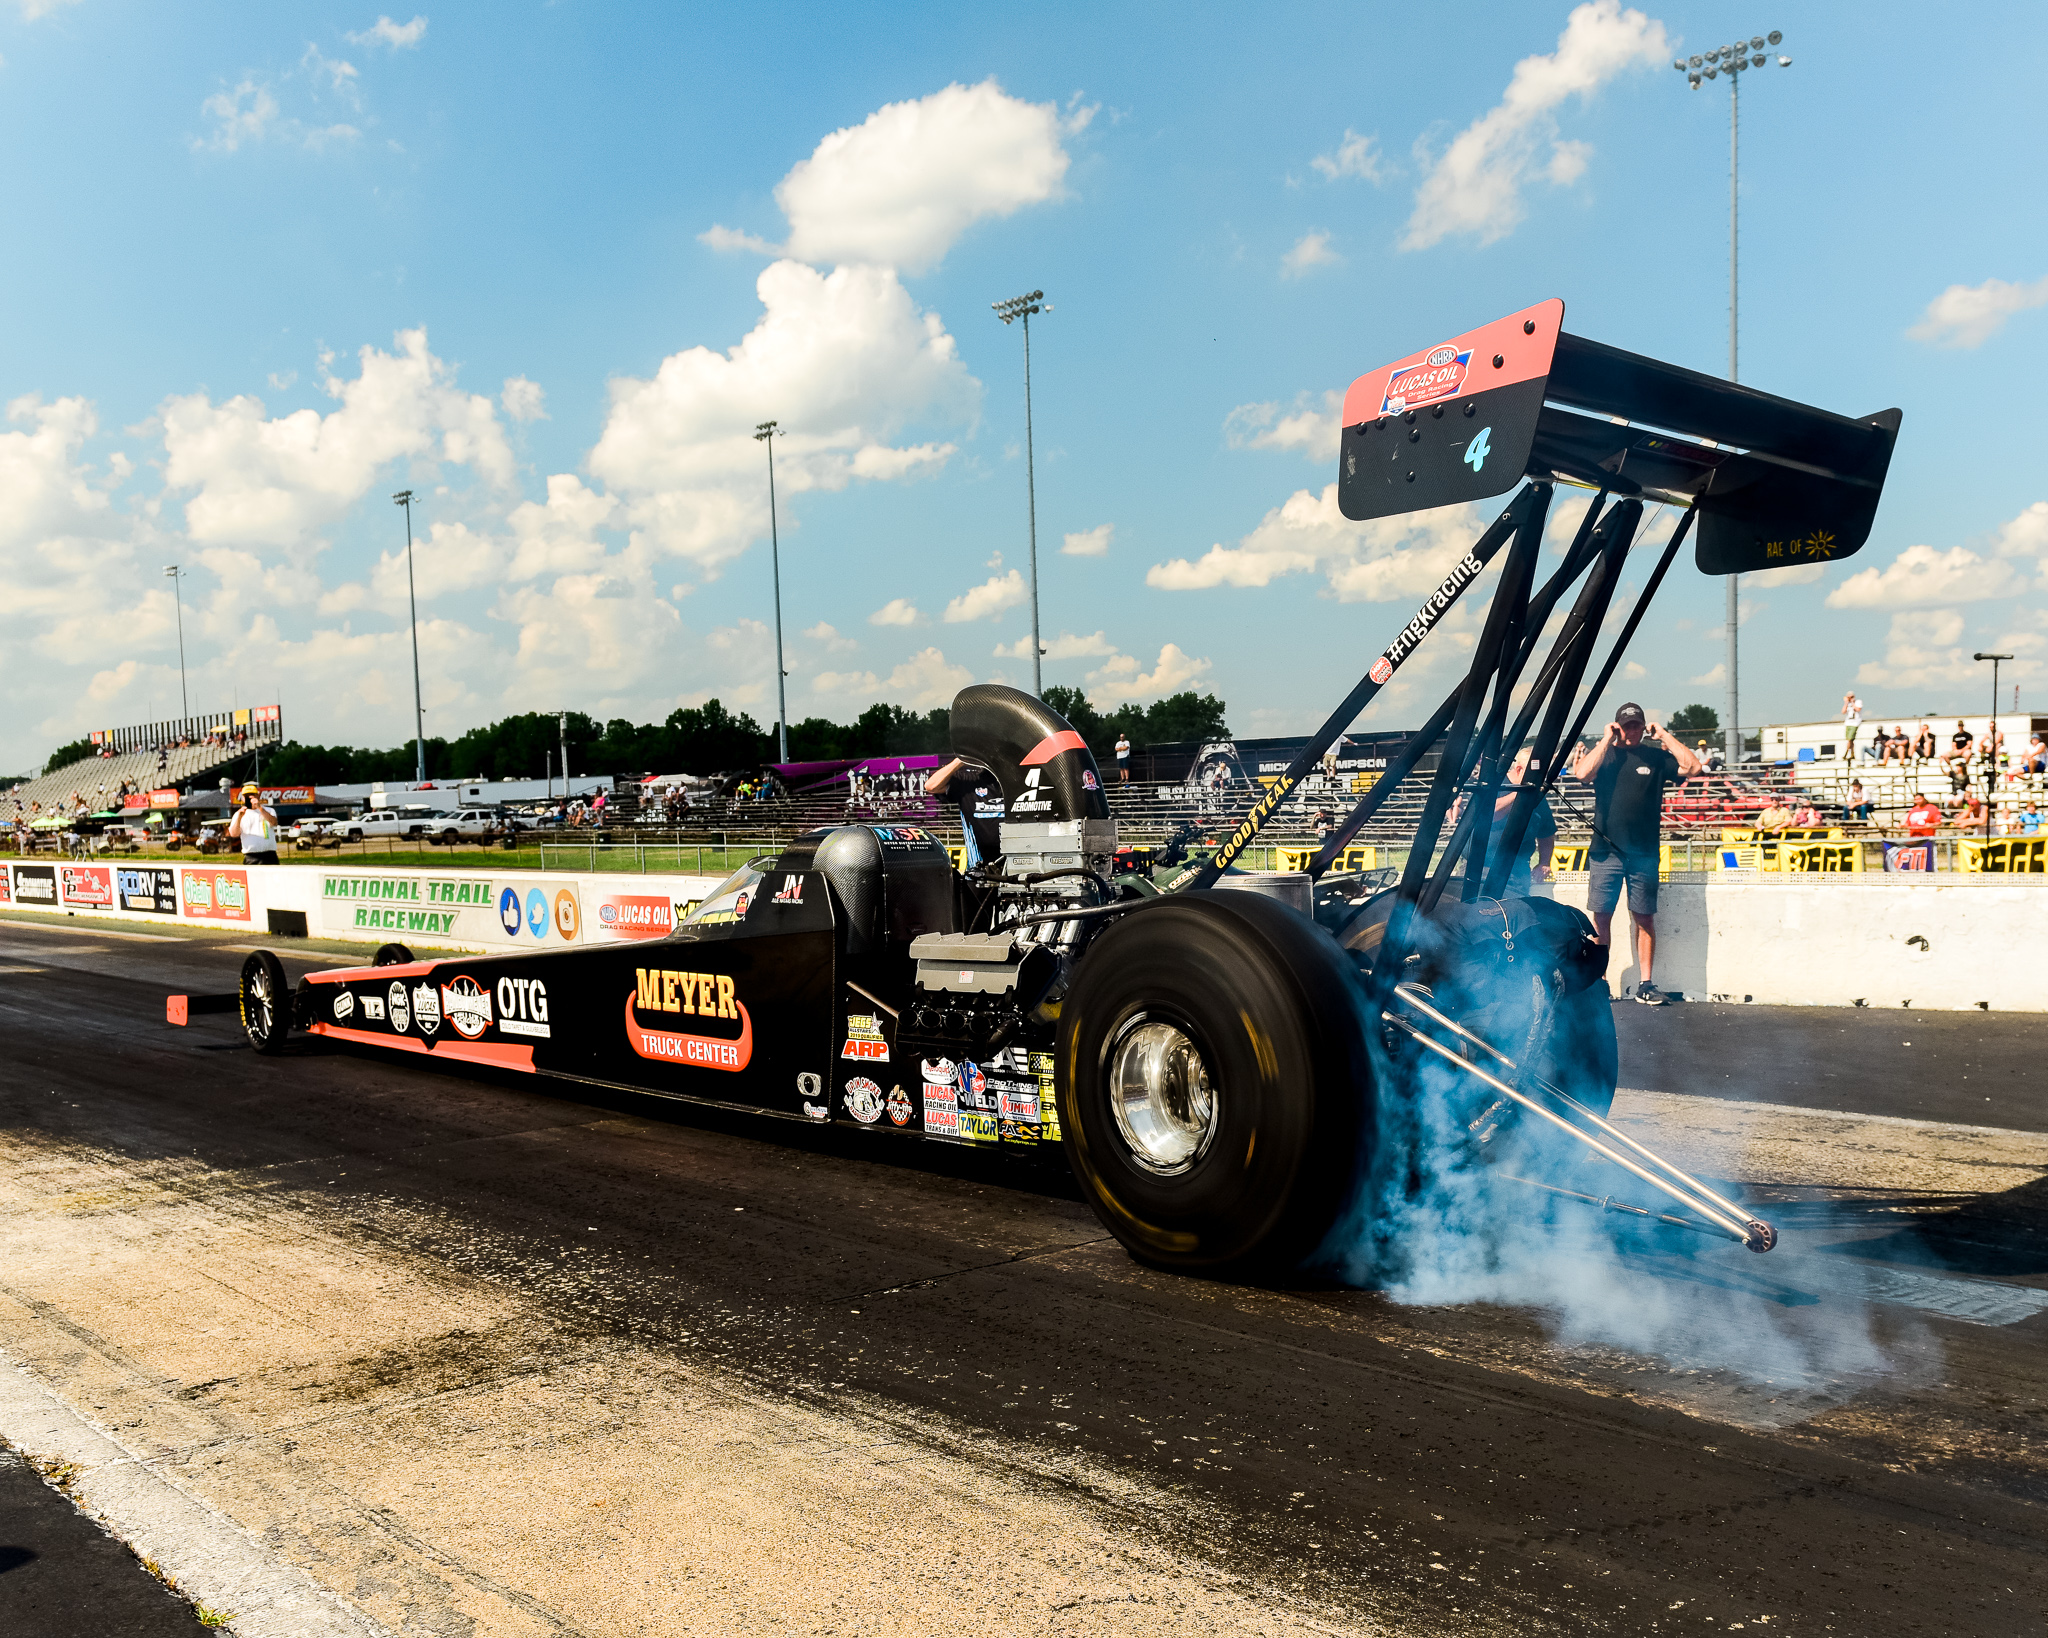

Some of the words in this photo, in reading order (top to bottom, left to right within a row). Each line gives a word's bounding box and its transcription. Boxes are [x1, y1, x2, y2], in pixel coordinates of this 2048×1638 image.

[1430, 350, 1455, 366] NHRA
[1391, 370, 1437, 396] LUCAS
[1437, 365, 1458, 383] OIL
[1408, 389, 1426, 398] Drag
[1428, 382, 1454, 392] Racing
[1417, 391, 1441, 400] Series
[1464, 427, 1491, 472] 4
[1766, 541, 1784, 558] RAE
[1790, 539, 1802, 555] OF
[1387, 550, 1483, 662] #ngkracing
[1311, 758, 1387, 771] THMPSON
[282, 789, 309, 800] GRILL
[1011, 800, 1053, 812] AEROMOTIVE
[324, 878, 420, 900] NATIONAL
[428, 882, 492, 904] TRAIL
[355, 908, 455, 933] RACEWAY
[601, 906, 617, 921] NHRA
[618, 905, 651, 925] LUCAS
[652, 906, 670, 926] OIL
[497, 976, 549, 1022] OTG
[636, 967, 738, 1019] MEYER
[417, 1001, 437, 1012] LUCAS
[849, 1016, 872, 1029] JEGS
[641, 1034, 683, 1058] TRUCK
[687, 1040, 739, 1065] CENTER
[843, 1040, 888, 1058] ARP
[958, 1060, 978, 1094] VP
[925, 1084, 956, 1102] LUCAS
[964, 1093, 998, 1110] WELD
[925, 1100, 947, 1110] RACING
[947, 1103, 957, 1111] OIL
[926, 1111, 957, 1127] LUCAS
[961, 1116, 998, 1137] TAYLOR
[926, 1124, 942, 1133] TRANS
[947, 1128, 958, 1136] DIFF
[1042, 1122, 1062, 1142] JE
